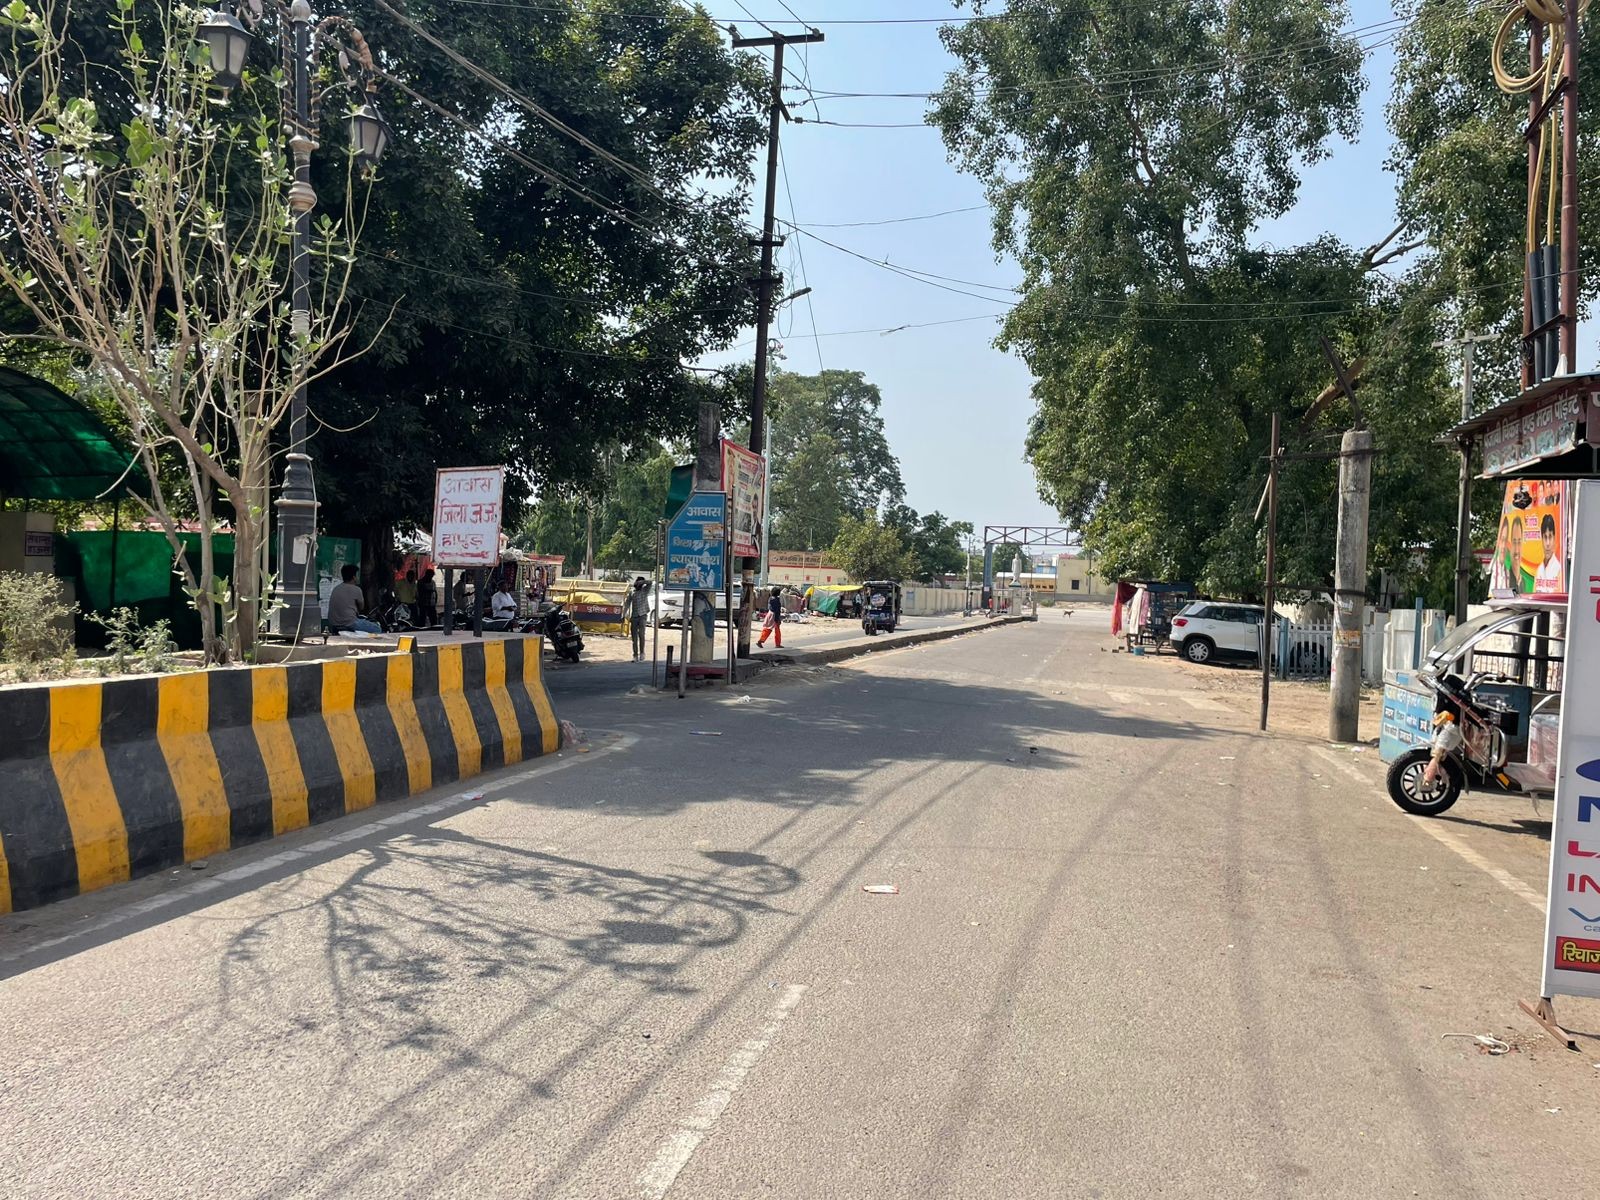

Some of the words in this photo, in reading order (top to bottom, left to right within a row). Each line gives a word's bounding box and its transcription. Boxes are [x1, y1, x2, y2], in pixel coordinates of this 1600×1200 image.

[443, 476, 494, 494] आवास
[440, 498, 468, 524] जिला
[686, 507, 721, 517] आवास
